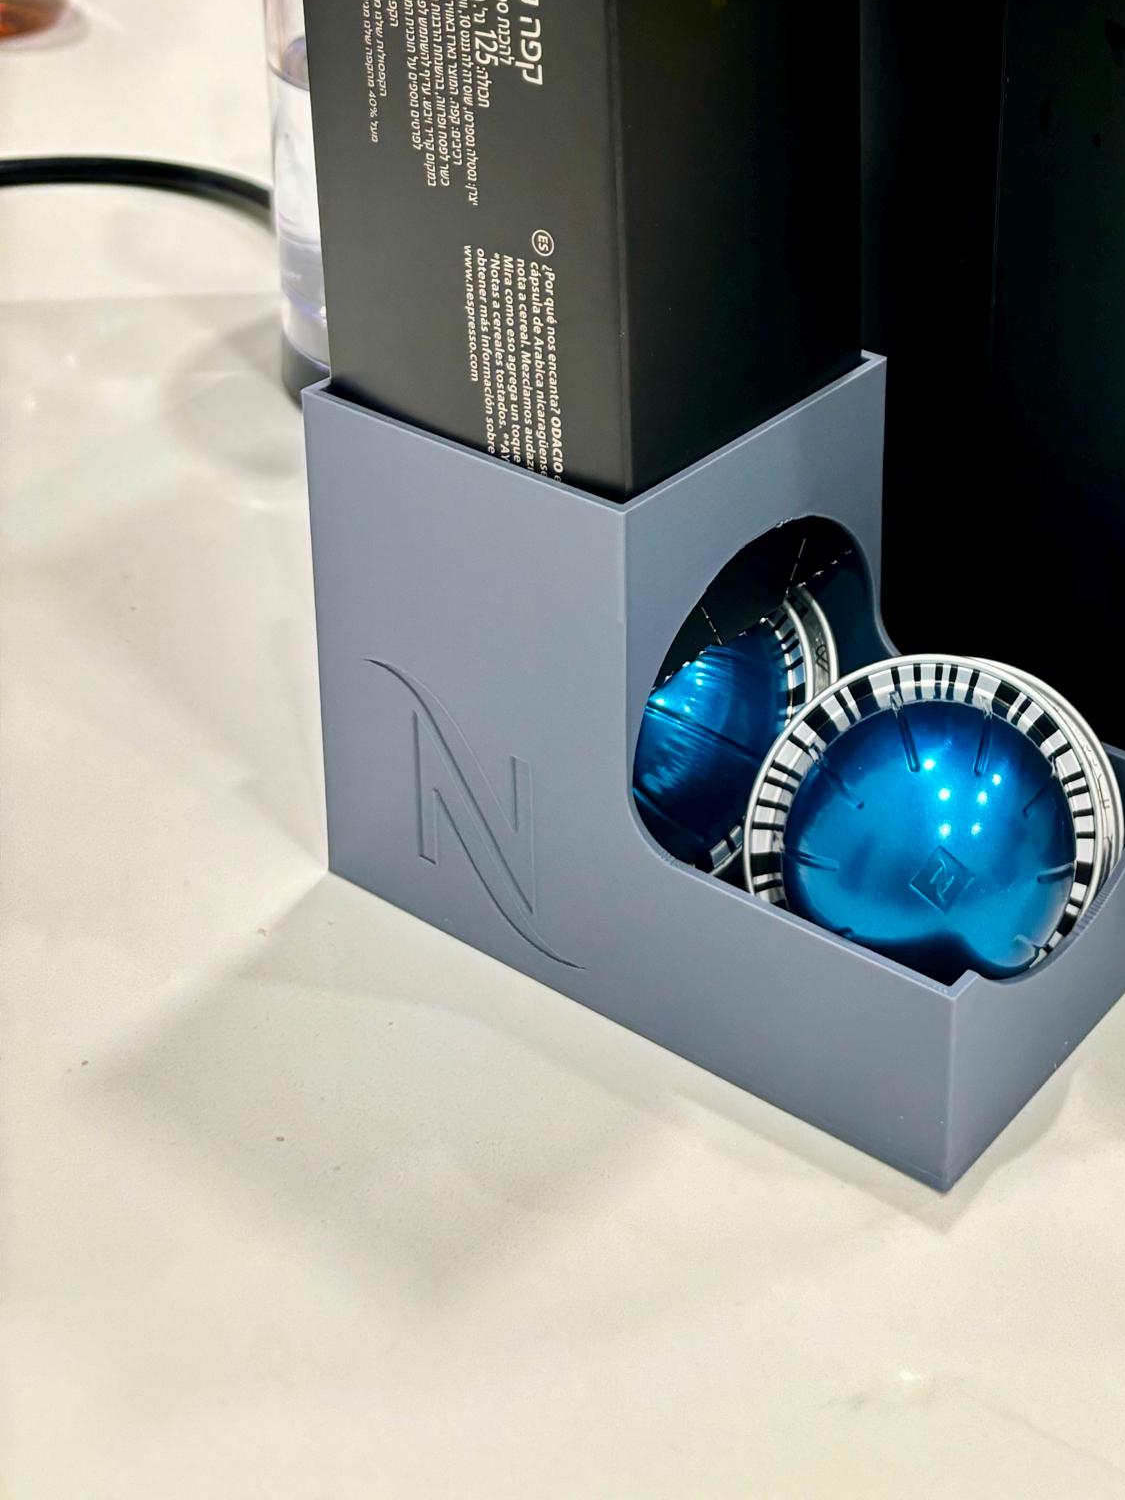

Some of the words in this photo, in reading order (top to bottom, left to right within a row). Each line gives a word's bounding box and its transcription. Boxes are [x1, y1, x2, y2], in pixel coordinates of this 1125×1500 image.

[473, 29, 499, 66] 125
[475, 247, 488, 303] obtener
[502, 253, 514, 286] Mira
[515, 257, 527, 290] nota
[527, 260, 543, 314] cápsula
[540, 263, 556, 296] ¿Por
[463, 244, 478, 382] www.nespresso.com
[491, 299, 500, 309] a
[504, 287, 514, 326] como
[517, 291, 526, 301] a
[542, 296, 558, 324] qué
[478, 303, 491, 332] más
[518, 302, 531, 348] cereal.
[531, 315, 544, 334] de
[491, 310, 505, 366] cereales
[505, 328, 515, 352] eso
[546, 325, 556, 351] nos
[480, 333, 495, 415] información
[505, 353, 518, 401] agrega
[533, 335, 546, 388] Arabica
[494, 368, 508, 429] tostados.
[520, 349, 533, 425] Mezclamos
[547, 352, 561, 415] encanta?
[509, 403, 519, 421] un
[485, 415, 497, 454] sobre
[509, 423, 521, 463] toque
[524, 426, 536, 472] audaz
[549, 415, 563, 472] ODACIO
